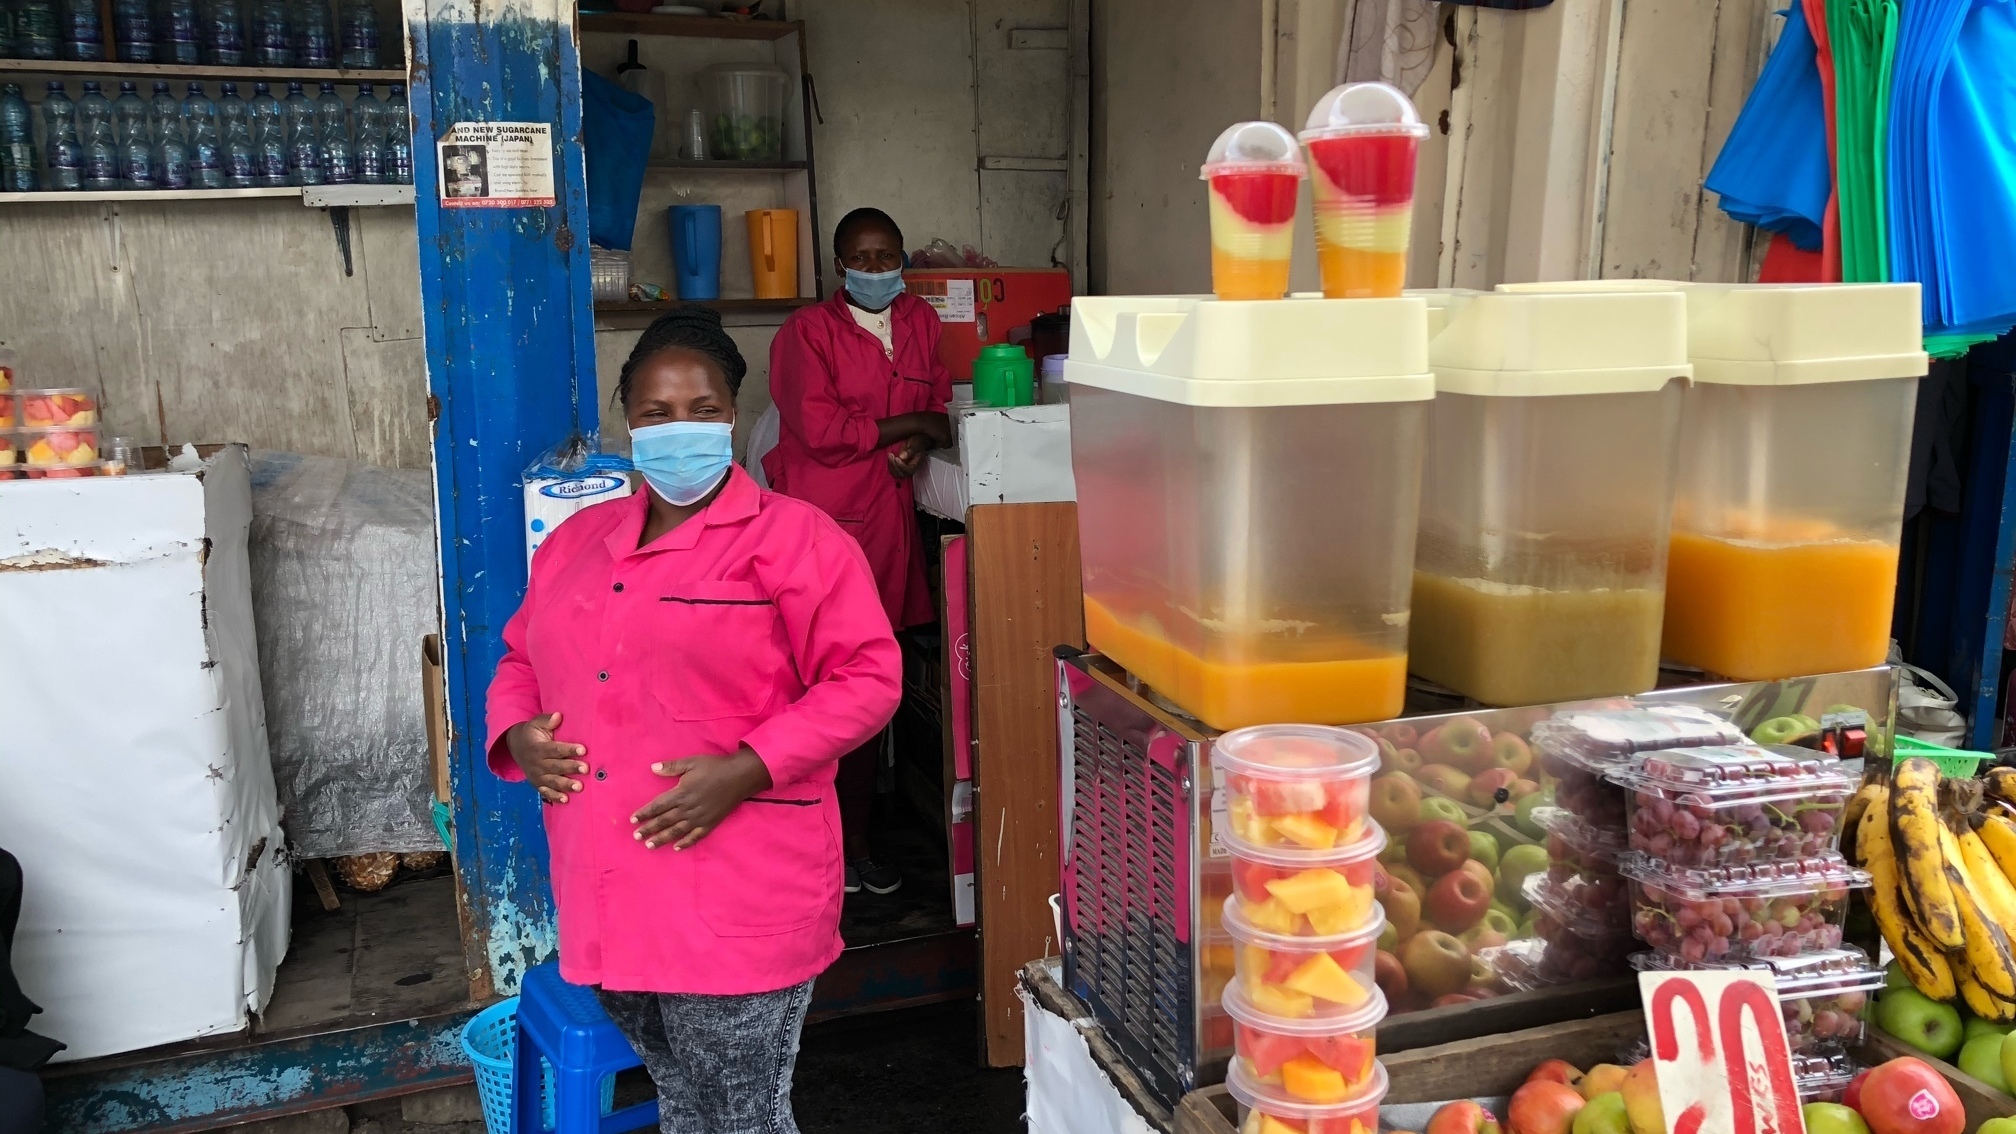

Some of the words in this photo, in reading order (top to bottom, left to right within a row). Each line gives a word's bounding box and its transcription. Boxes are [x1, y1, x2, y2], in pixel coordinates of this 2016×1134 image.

[473, 126, 494, 134] NEW
[496, 126, 547, 135] SUGARCANE
[455, 135, 498, 143] MACHINE
[501, 135, 533, 144] (JAPAN)
